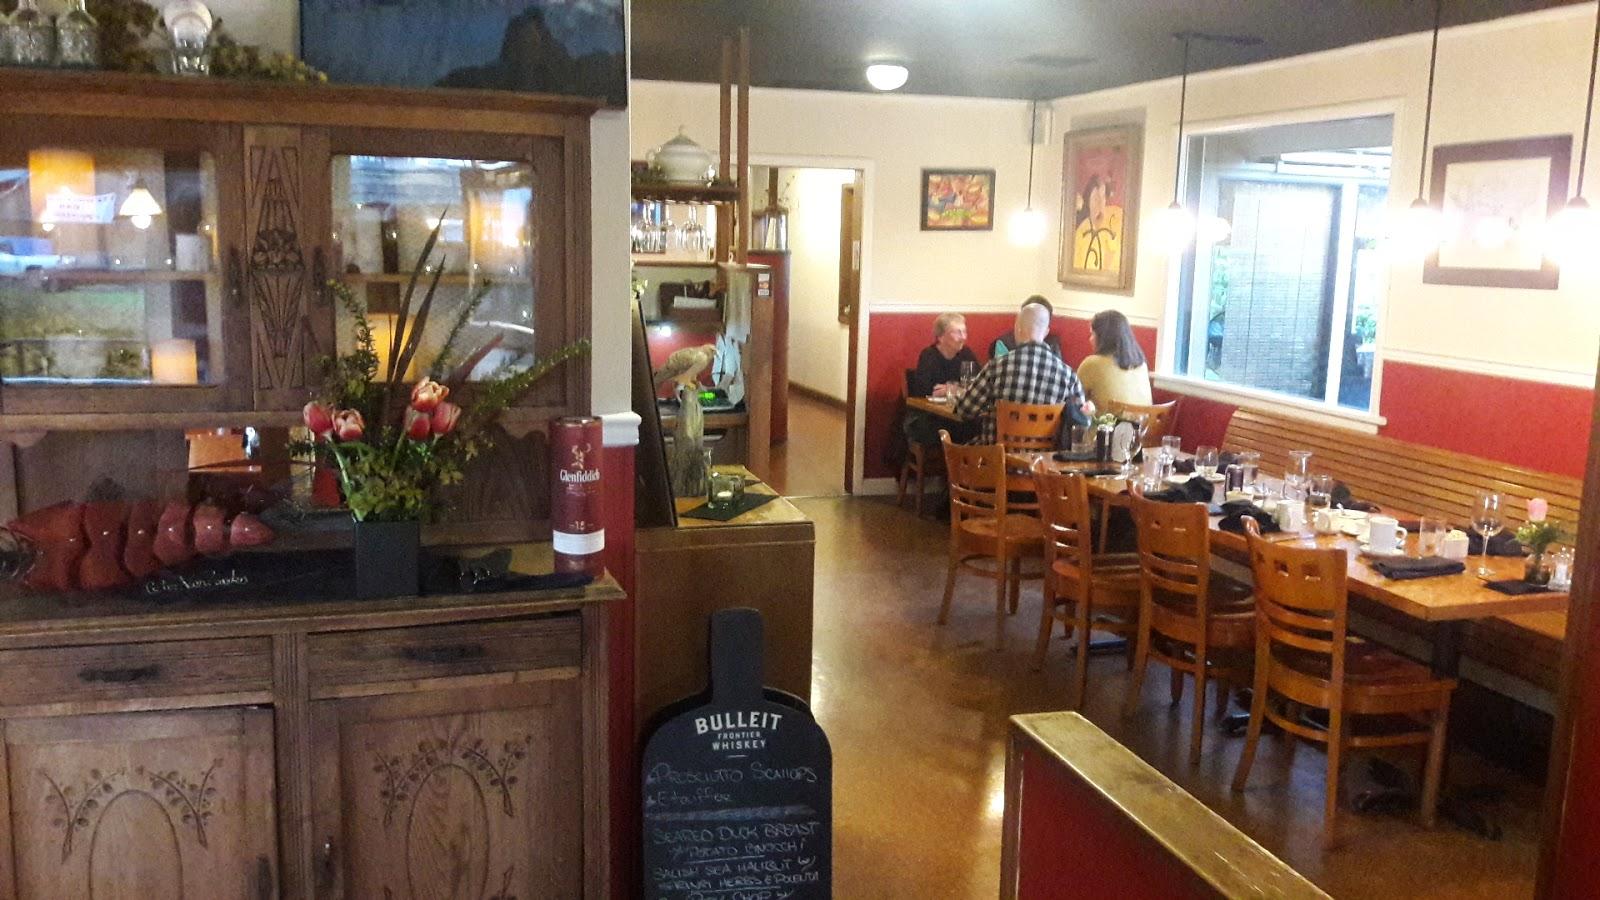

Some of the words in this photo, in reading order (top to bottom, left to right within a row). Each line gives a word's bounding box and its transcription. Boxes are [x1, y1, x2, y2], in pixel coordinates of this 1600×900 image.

[560, 468, 600, 484] Glenfiddich
[695, 711, 783, 735] BULLEIT
[718, 731, 761, 740] FRONTIER
[712, 739, 767, 750] WHISKEY
